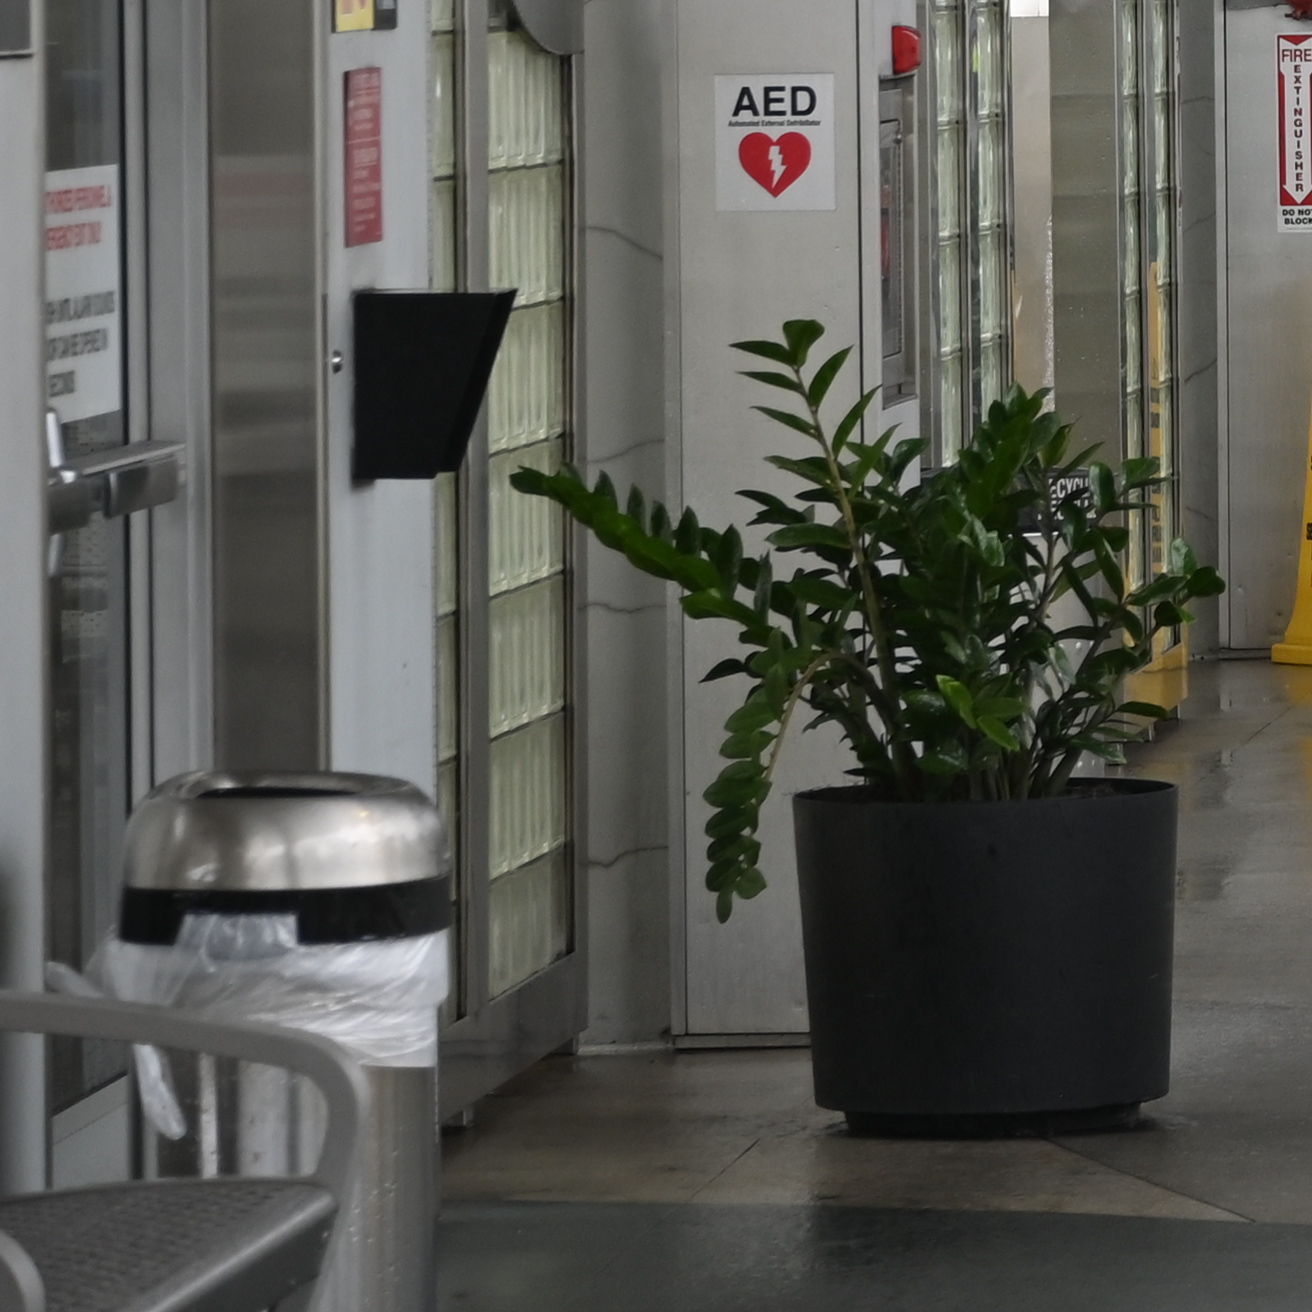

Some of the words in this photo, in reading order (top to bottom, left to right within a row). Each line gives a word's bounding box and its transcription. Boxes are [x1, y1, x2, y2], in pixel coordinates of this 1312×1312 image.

[1281, 49, 1312, 62] FIRE
[732, 85, 817, 117] AED
[1293, 64, 1305, 192] EXTINGUISHER
[1282, 209, 1296, 217] DO
